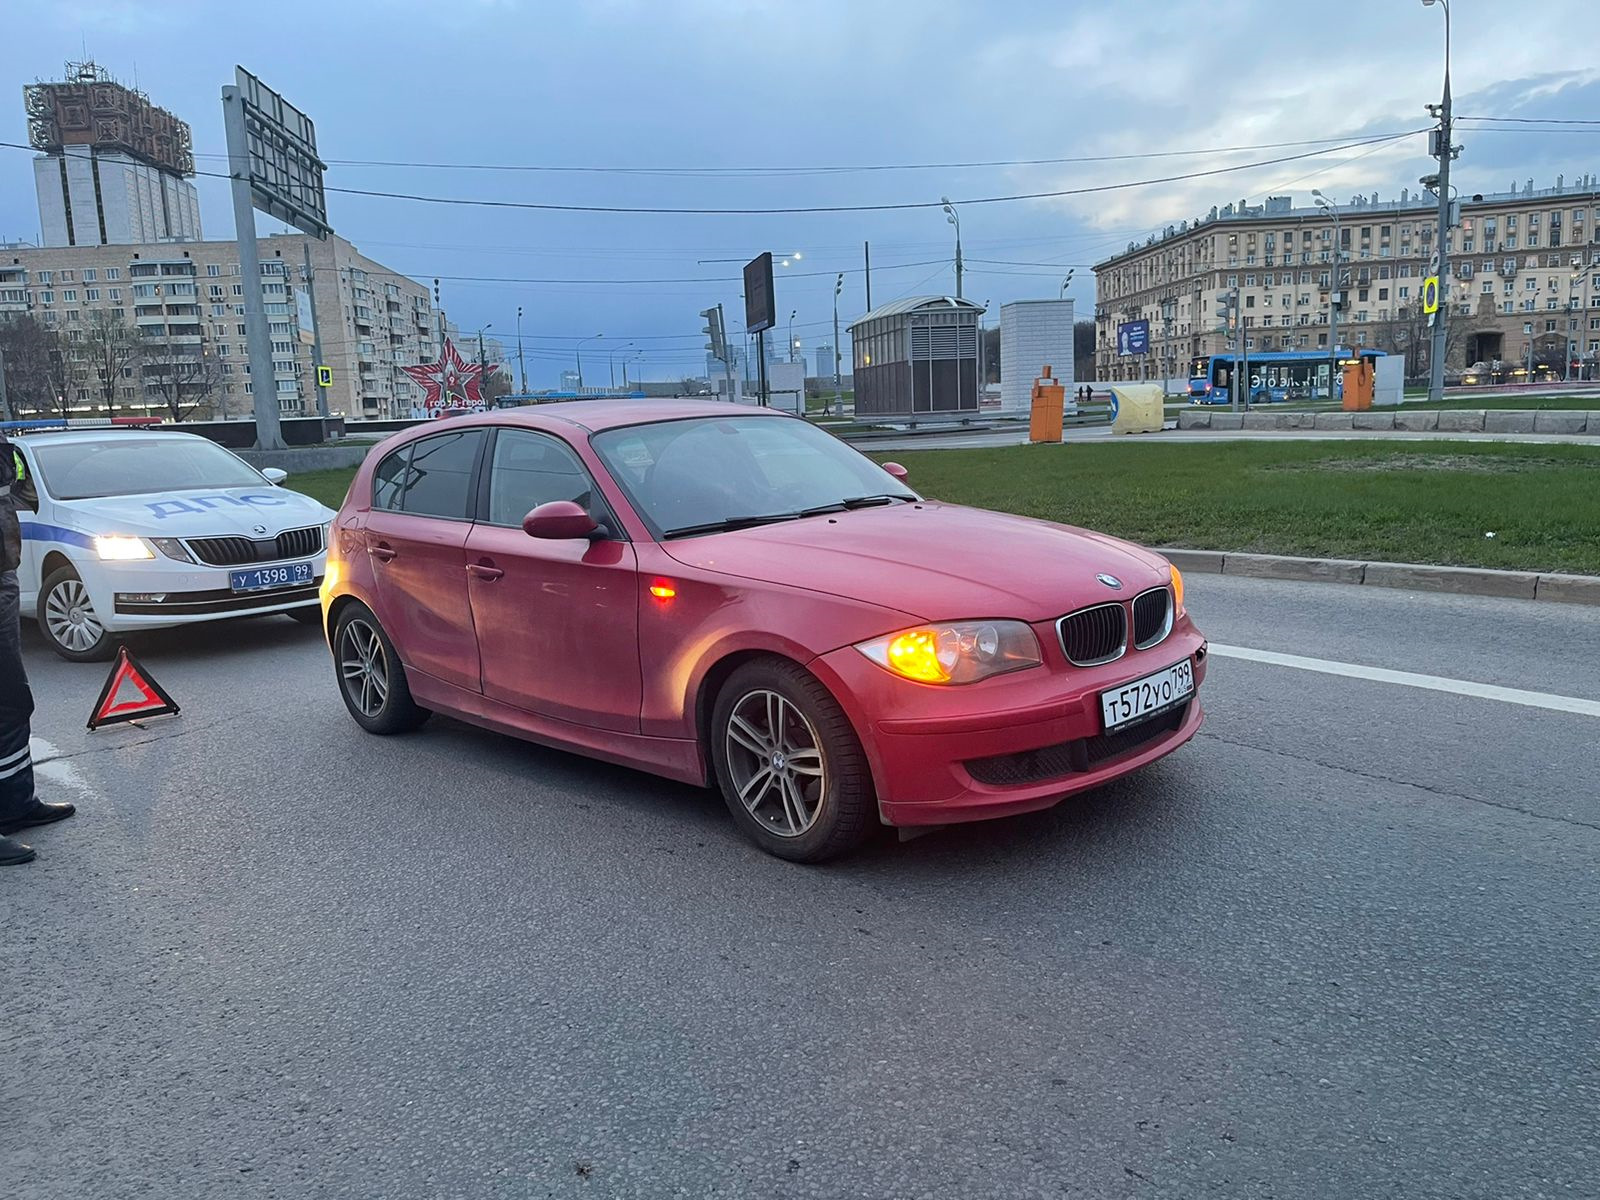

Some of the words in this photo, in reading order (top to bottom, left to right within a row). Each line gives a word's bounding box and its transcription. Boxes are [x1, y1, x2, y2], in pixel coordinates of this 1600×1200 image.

[1251, 375, 1276, 388] Это
[144, 495, 287, 519] ДПС
[239, 575, 247, 587] У
[254, 568, 288, 585] 1398
[295, 564, 308, 576] 99
[1172, 663, 1189, 689] 799
